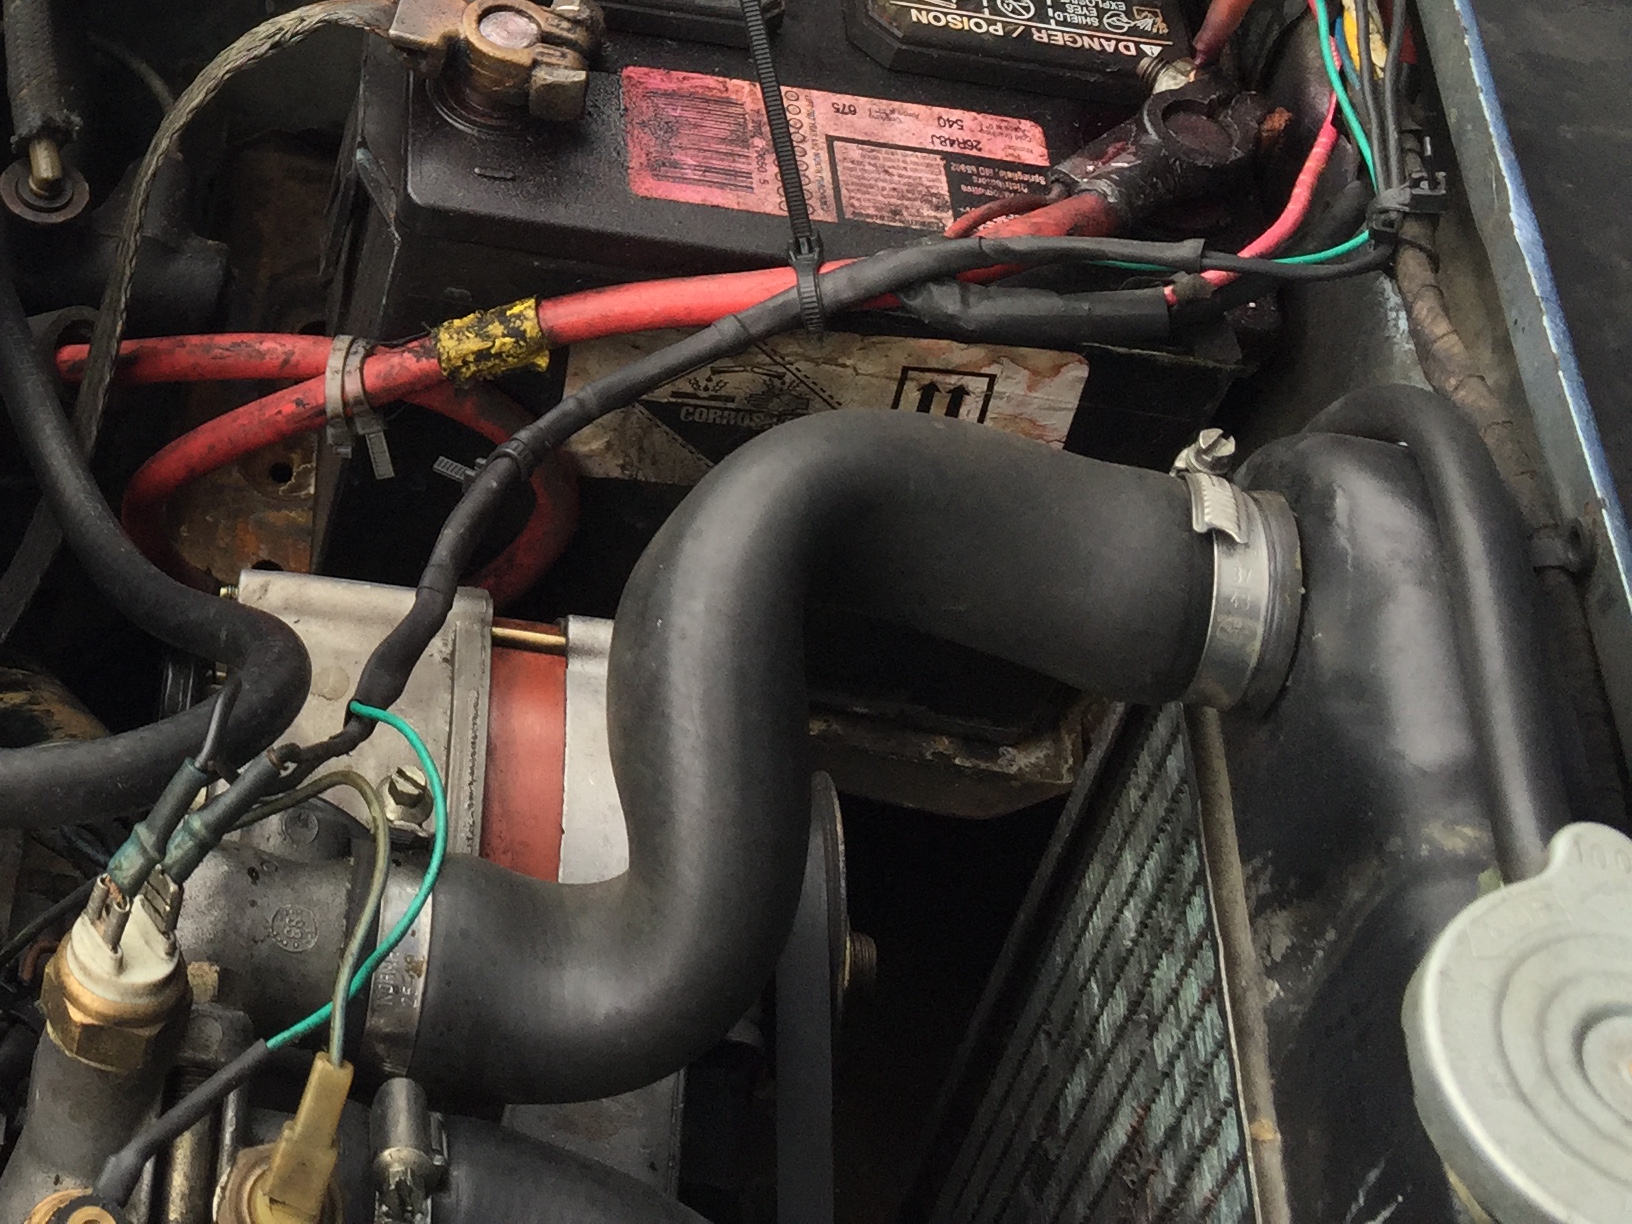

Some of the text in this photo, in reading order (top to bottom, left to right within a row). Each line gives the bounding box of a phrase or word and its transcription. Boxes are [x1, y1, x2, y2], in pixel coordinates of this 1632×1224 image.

[1065, 3, 1098, 16] EYES
[1054, 11, 1099, 26] SHIELD
[910, 8, 1137, 56] DANGER / POISON
[831, 102, 858, 116] 675
[937, 116, 965, 132] 540
[929, 134, 982, 152] 26R48J
